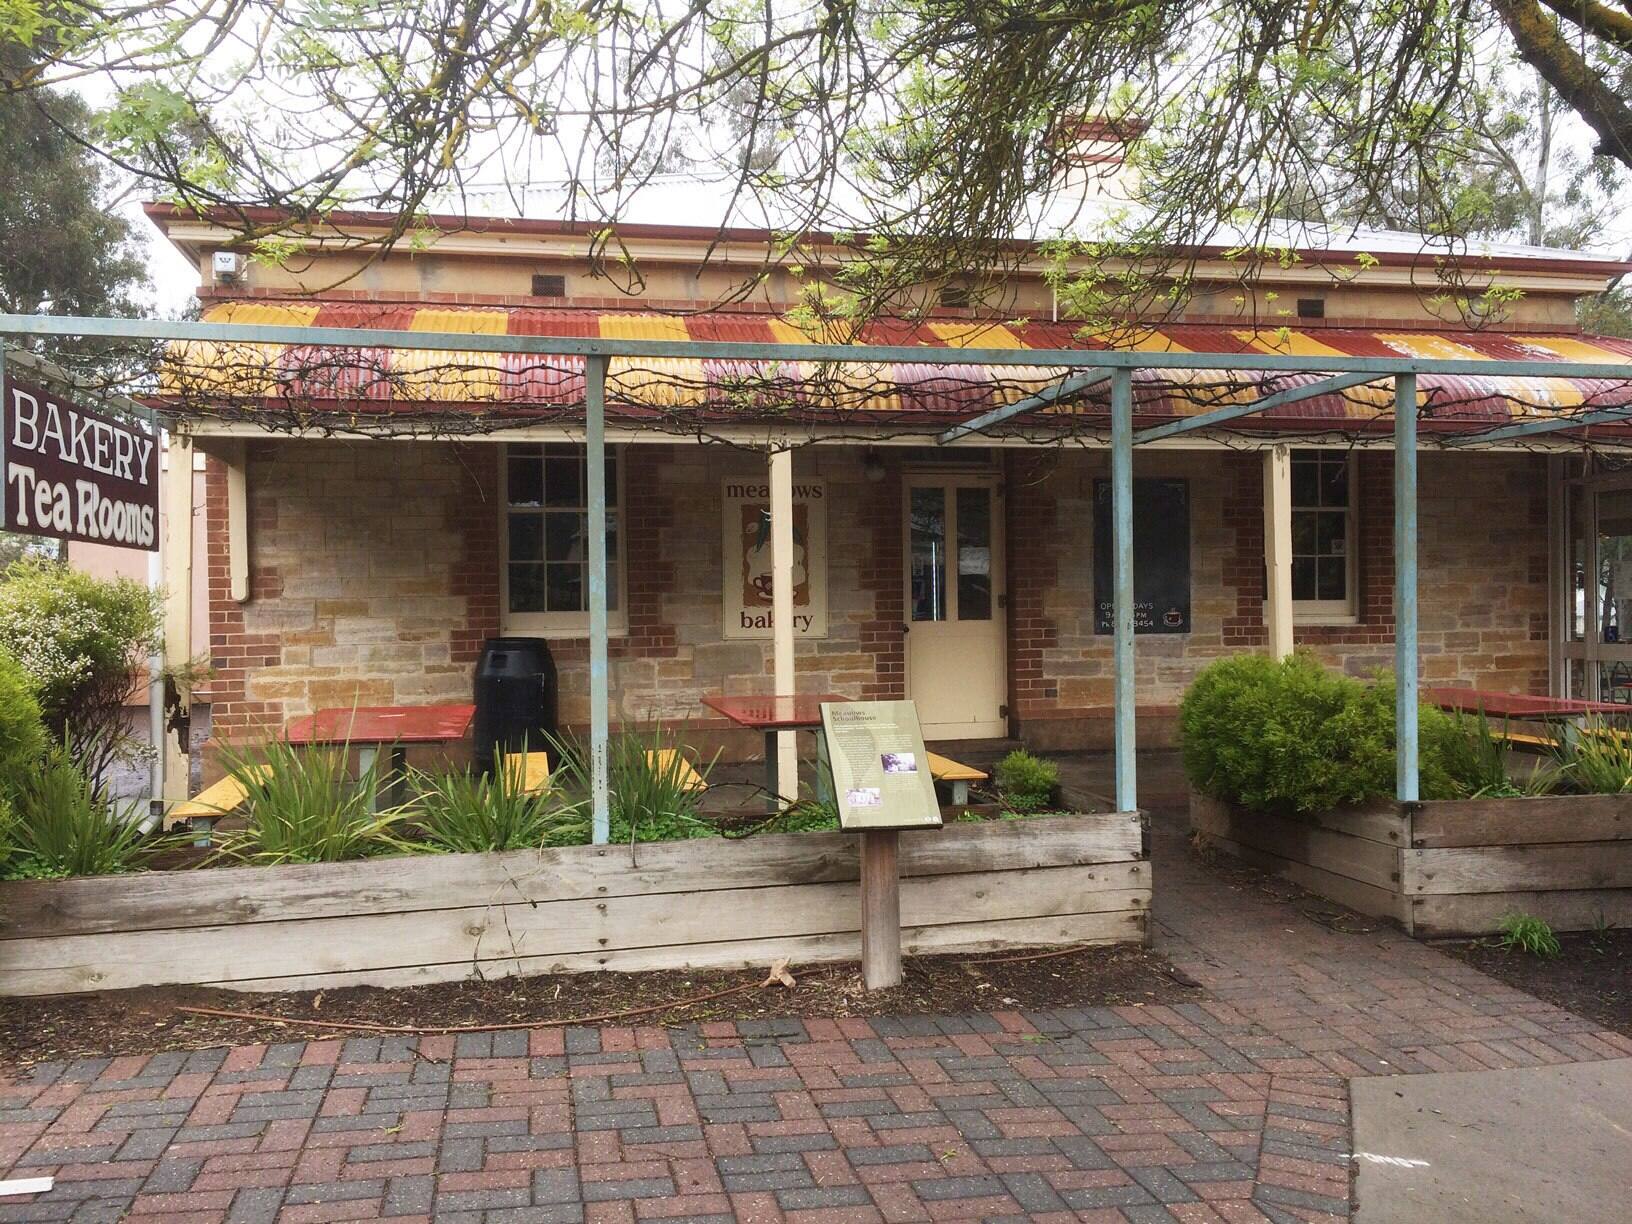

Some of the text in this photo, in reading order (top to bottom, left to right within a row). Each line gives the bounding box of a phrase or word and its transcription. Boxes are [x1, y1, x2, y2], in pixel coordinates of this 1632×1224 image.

[12, 388, 153, 485] BAKERY
[8, 462, 154, 546] Tea Rooms
[726, 484, 823, 499] meaws
[740, 611, 813, 632] bakry
